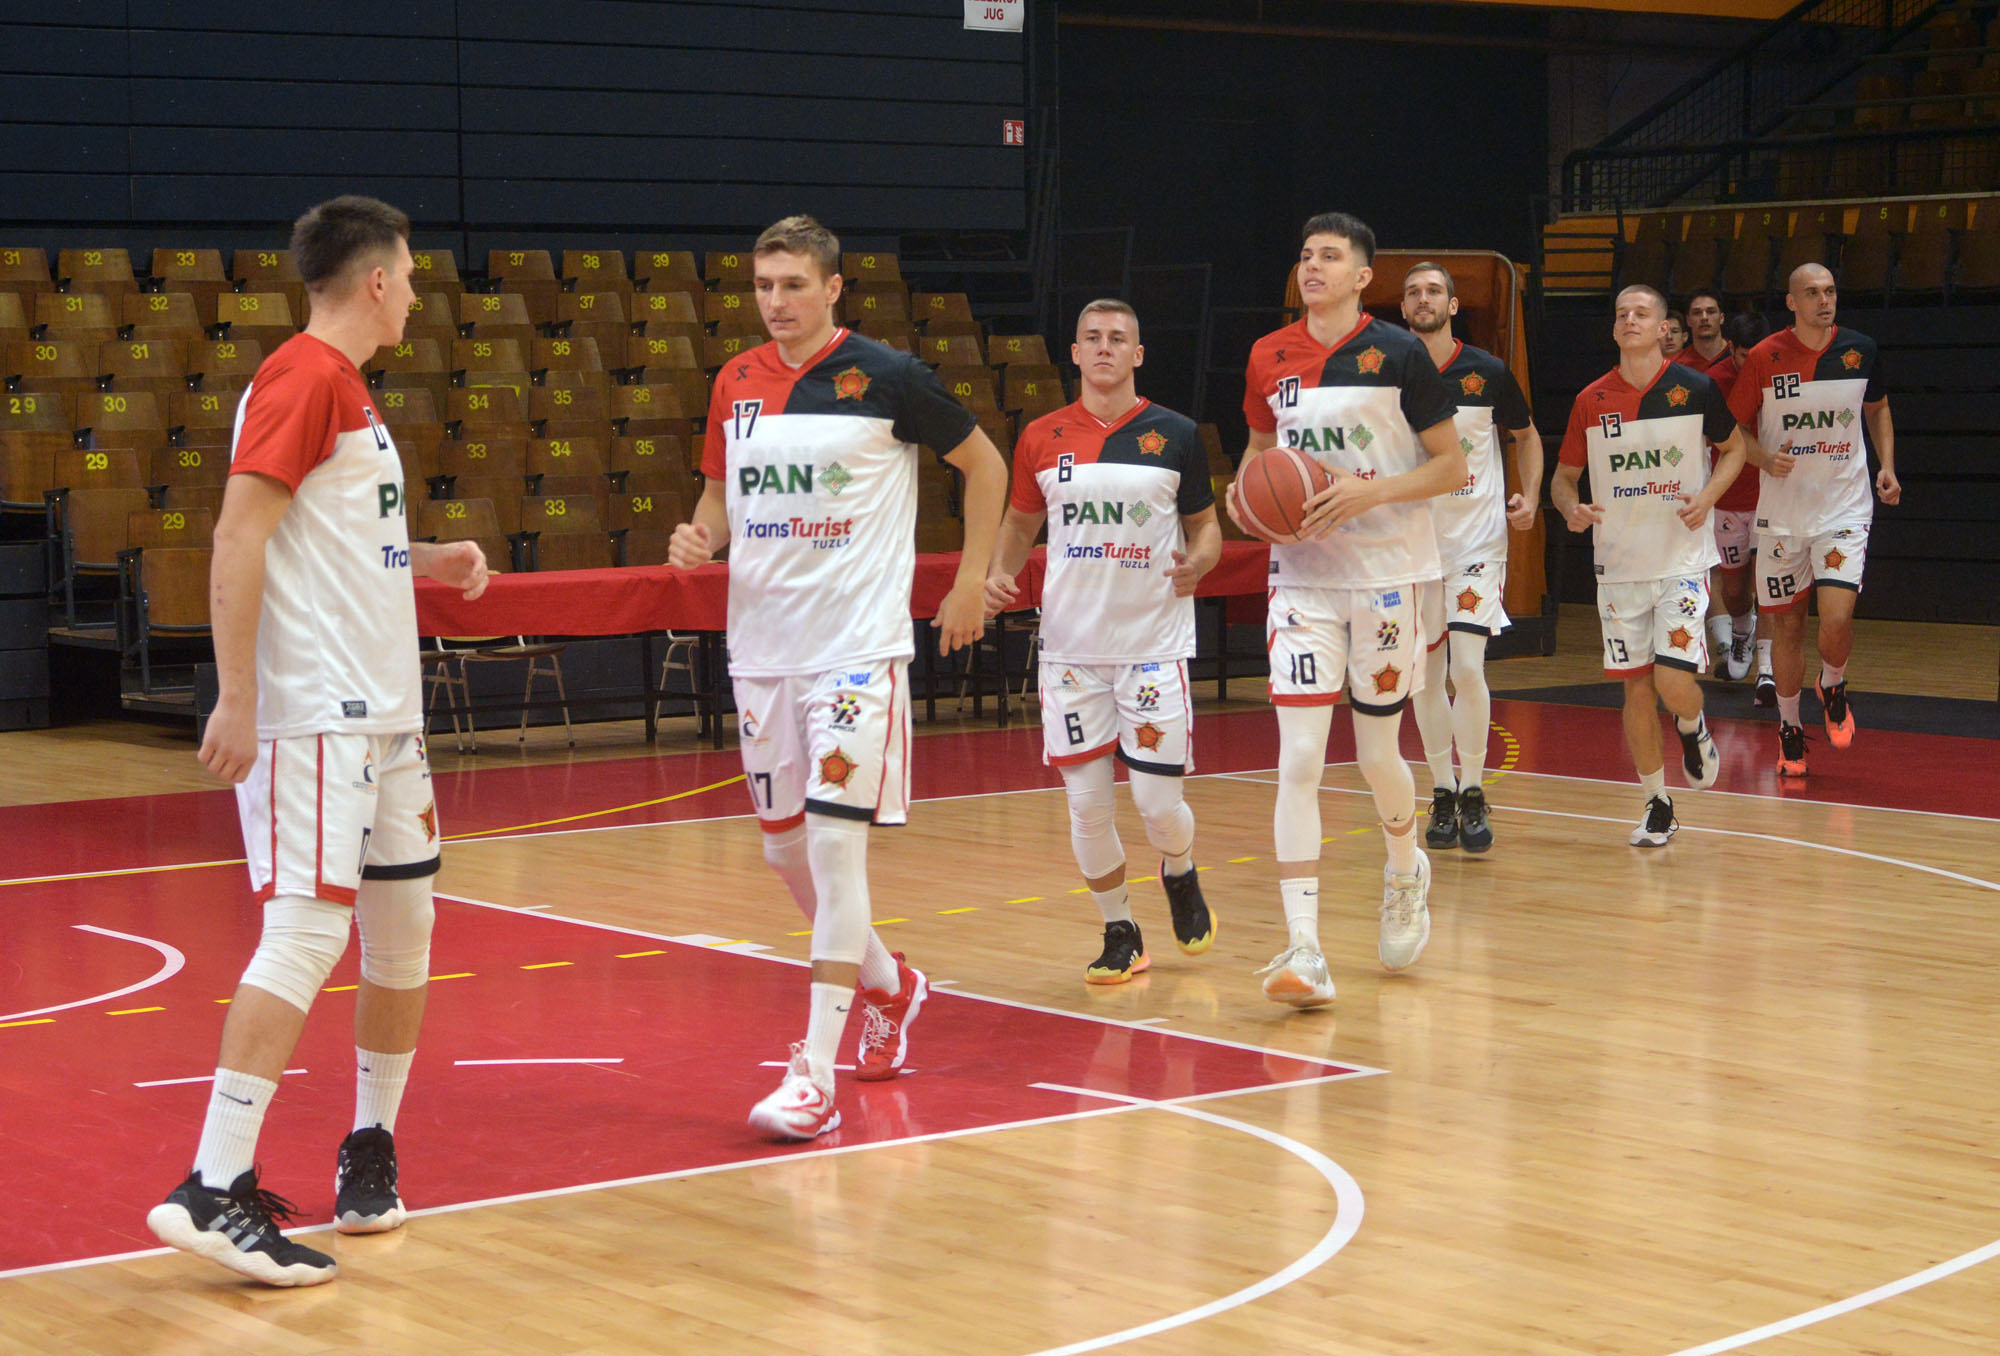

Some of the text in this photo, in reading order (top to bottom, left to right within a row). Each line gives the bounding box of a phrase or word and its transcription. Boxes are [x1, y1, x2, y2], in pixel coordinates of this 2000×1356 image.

[984, 7, 1004, 20] JUG
[1763, 213, 1772, 226] 3
[1879, 207, 1889, 221] 5
[3, 250, 22, 266] 31
[84, 251, 103, 266] 32
[176, 251, 195, 266] 33
[259, 252, 278, 267] 34
[508, 251, 525, 266] 37
[583, 254, 601, 270] 38
[652, 252, 670, 268] 39
[721, 255, 738, 268] 40
[861, 256, 876, 269] 42
[65, 296, 83, 312] 31
[150, 295, 169, 312] 32
[239, 296, 260, 312] 33
[482, 296, 501, 311] 36
[579, 294, 595, 310] 37
[723, 294, 741, 309] 39
[864, 296, 877, 309] 41
[930, 296, 945, 309] 42
[35, 345, 59, 361] 30
[130, 343, 150, 360] 31
[216, 343, 237, 360] 32
[394, 343, 415, 358] 34
[473, 342, 492, 358] 35
[552, 340, 571, 356] 36
[648, 338, 669, 355] 36
[724, 338, 740, 353] 37
[954, 381, 973, 397] 40
[1277, 376, 1300, 409] 10
[1772, 373, 1800, 400] 82
[103, 394, 127, 413] 30
[201, 394, 220, 412] 31
[384, 392, 405, 408] 33
[468, 393, 489, 411] 34
[553, 389, 573, 406] 35
[632, 387, 651, 404] 36
[9, 396, 37, 415] 29
[733, 399, 763, 440] 17
[1600, 413, 1622, 439] 13
[1782, 410, 1834, 431] PAN
[635, 439, 656, 456] 35
[1287, 427, 1345, 452] PAN
[466, 442, 488, 459] 33
[550, 440, 571, 458] 34
[85, 453, 109, 471] 29
[178, 451, 202, 468] 30
[1057, 453, 1074, 483] 6
[1609, 449, 1661, 472] PAN
[739, 464, 814, 496] PAN
[1613, 480, 1681, 498] TransTurist
[445, 502, 468, 520] 32
[545, 499, 567, 517] 33
[632, 496, 653, 513] 34
[162, 512, 186, 531] 29
[1062, 502, 1124, 526] PAN
[812, 538, 850, 550] TUZLA
[1722, 546, 1740, 564] 12
[1120, 560, 1150, 569] TUZLA
[1767, 574, 1796, 599] 82
[1607, 638, 1629, 663] 13
[1290, 652, 1316, 685] 10
[1064, 712, 1085, 746] 6
